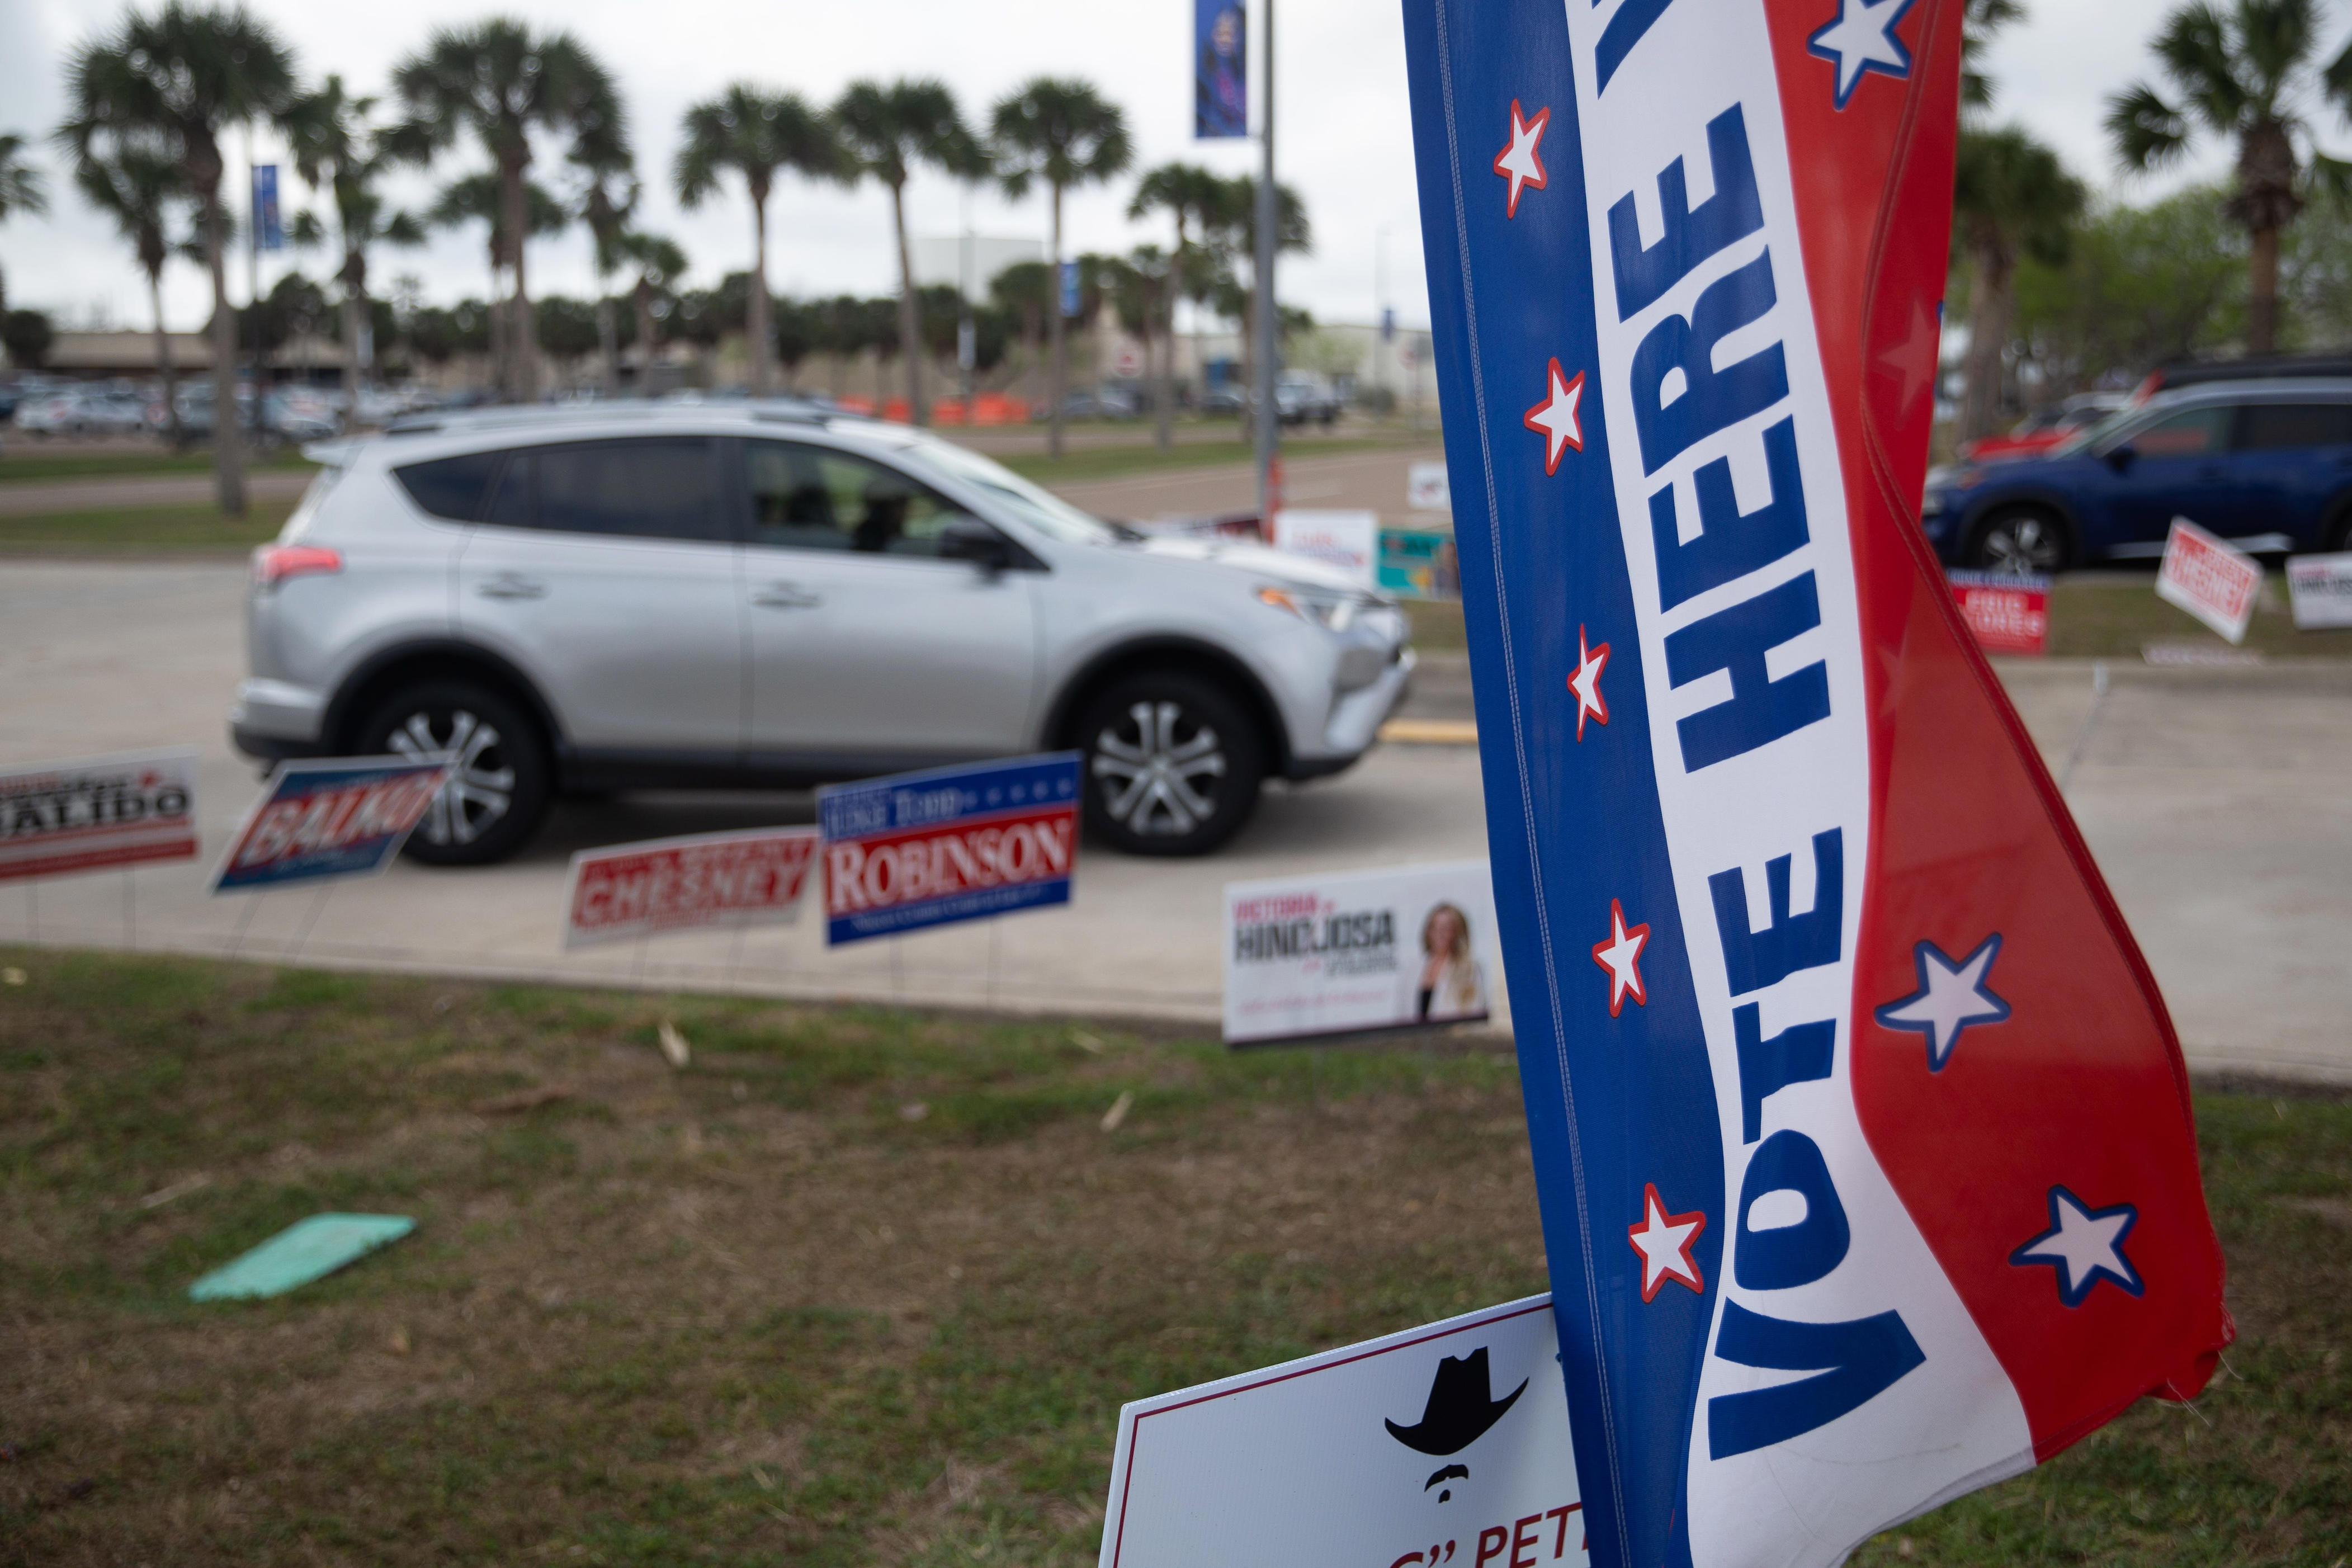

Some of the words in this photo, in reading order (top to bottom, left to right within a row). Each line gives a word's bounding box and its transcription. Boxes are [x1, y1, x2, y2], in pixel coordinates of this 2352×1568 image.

[1607, 101, 1831, 774] HERE
[829, 815, 1073, 915] ROBINSON
[1707, 825, 1927, 1461] VOTE
[1474, 1501, 1589, 1568] PET
